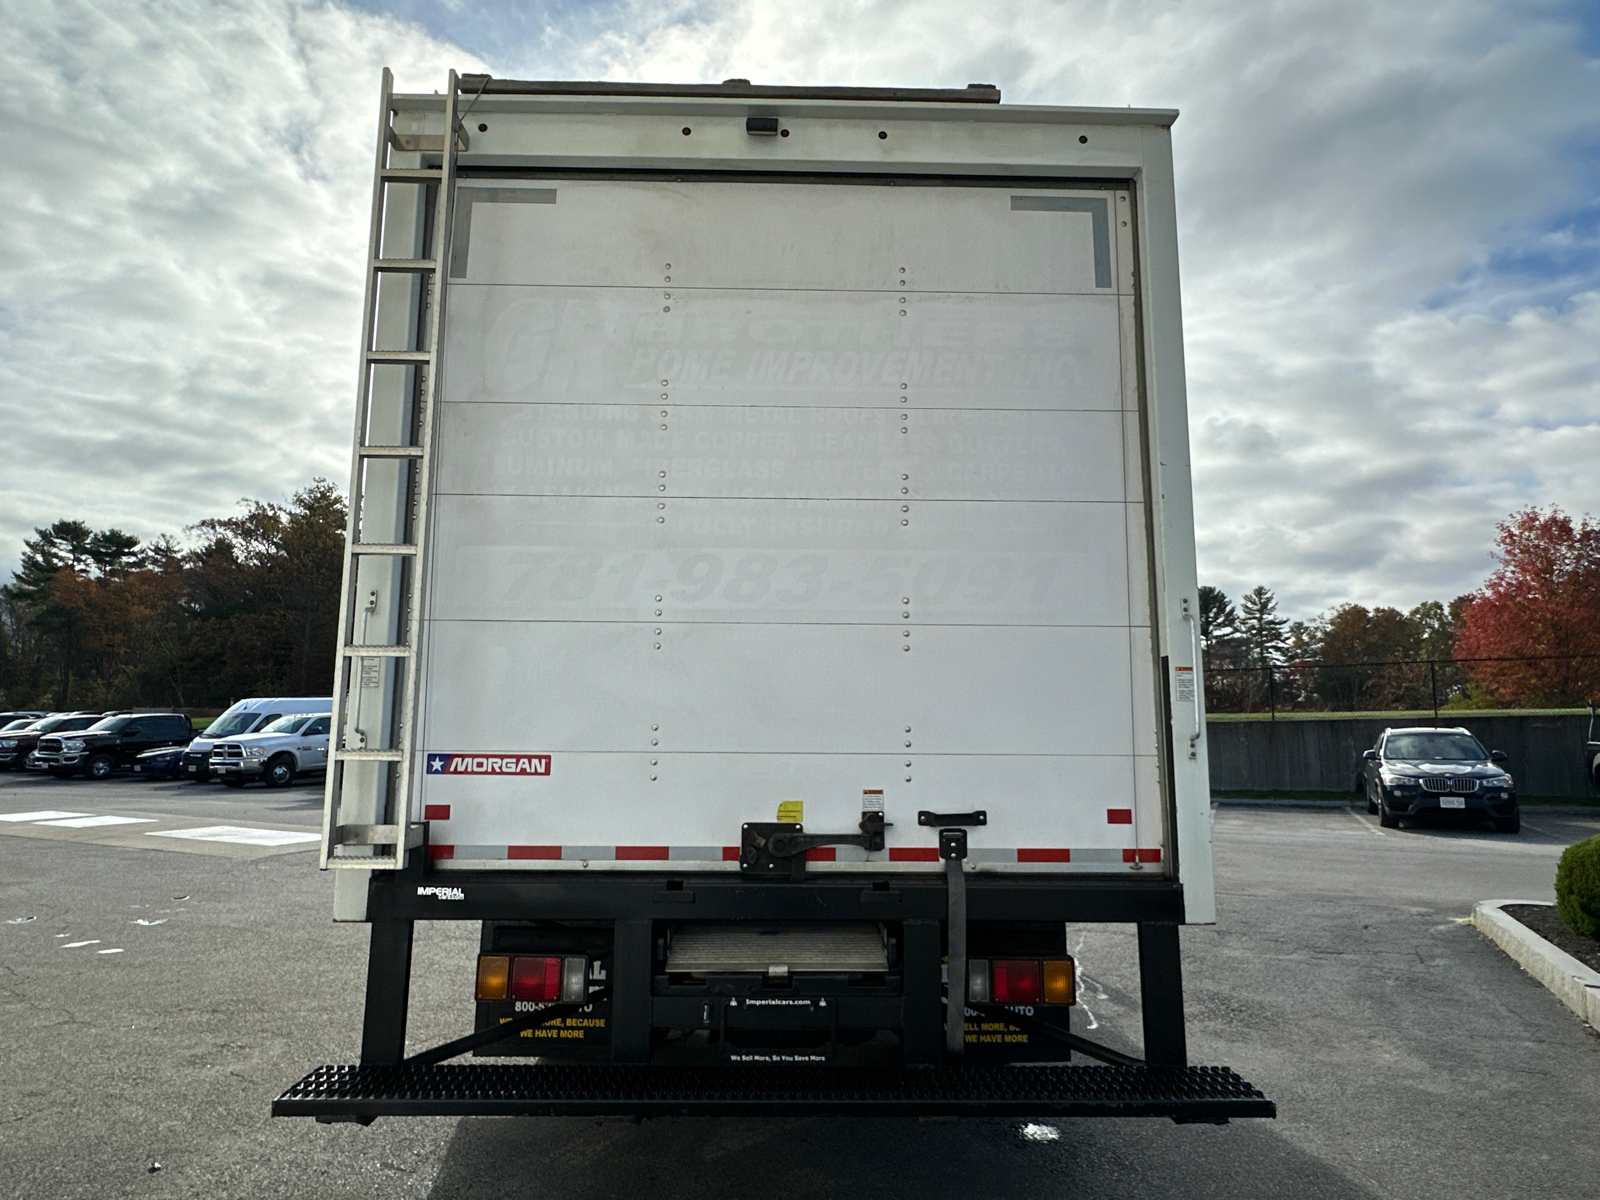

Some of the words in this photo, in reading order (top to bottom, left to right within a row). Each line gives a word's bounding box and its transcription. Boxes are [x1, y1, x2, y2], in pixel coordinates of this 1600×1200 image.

[631, 349, 736, 381] HOME
[745, 350, 1004, 385] IMPROVEMENT
[503, 551, 1061, 607] 781-983-5091
[450, 757, 546, 773] MORGAN
[417, 886, 464, 897] IMPERIAL
[566, 1018, 606, 1027] BECAUSE
[981, 1023, 1008, 1032] MORE,
[520, 1029, 533, 1038] WE
[535, 1030, 559, 1038] HAVE
[560, 1030, 585, 1039] MORE
[964, 1034, 978, 1042] WE
[980, 1034, 1003, 1042] HAVE
[1004, 1034, 1029, 1043] MORE
